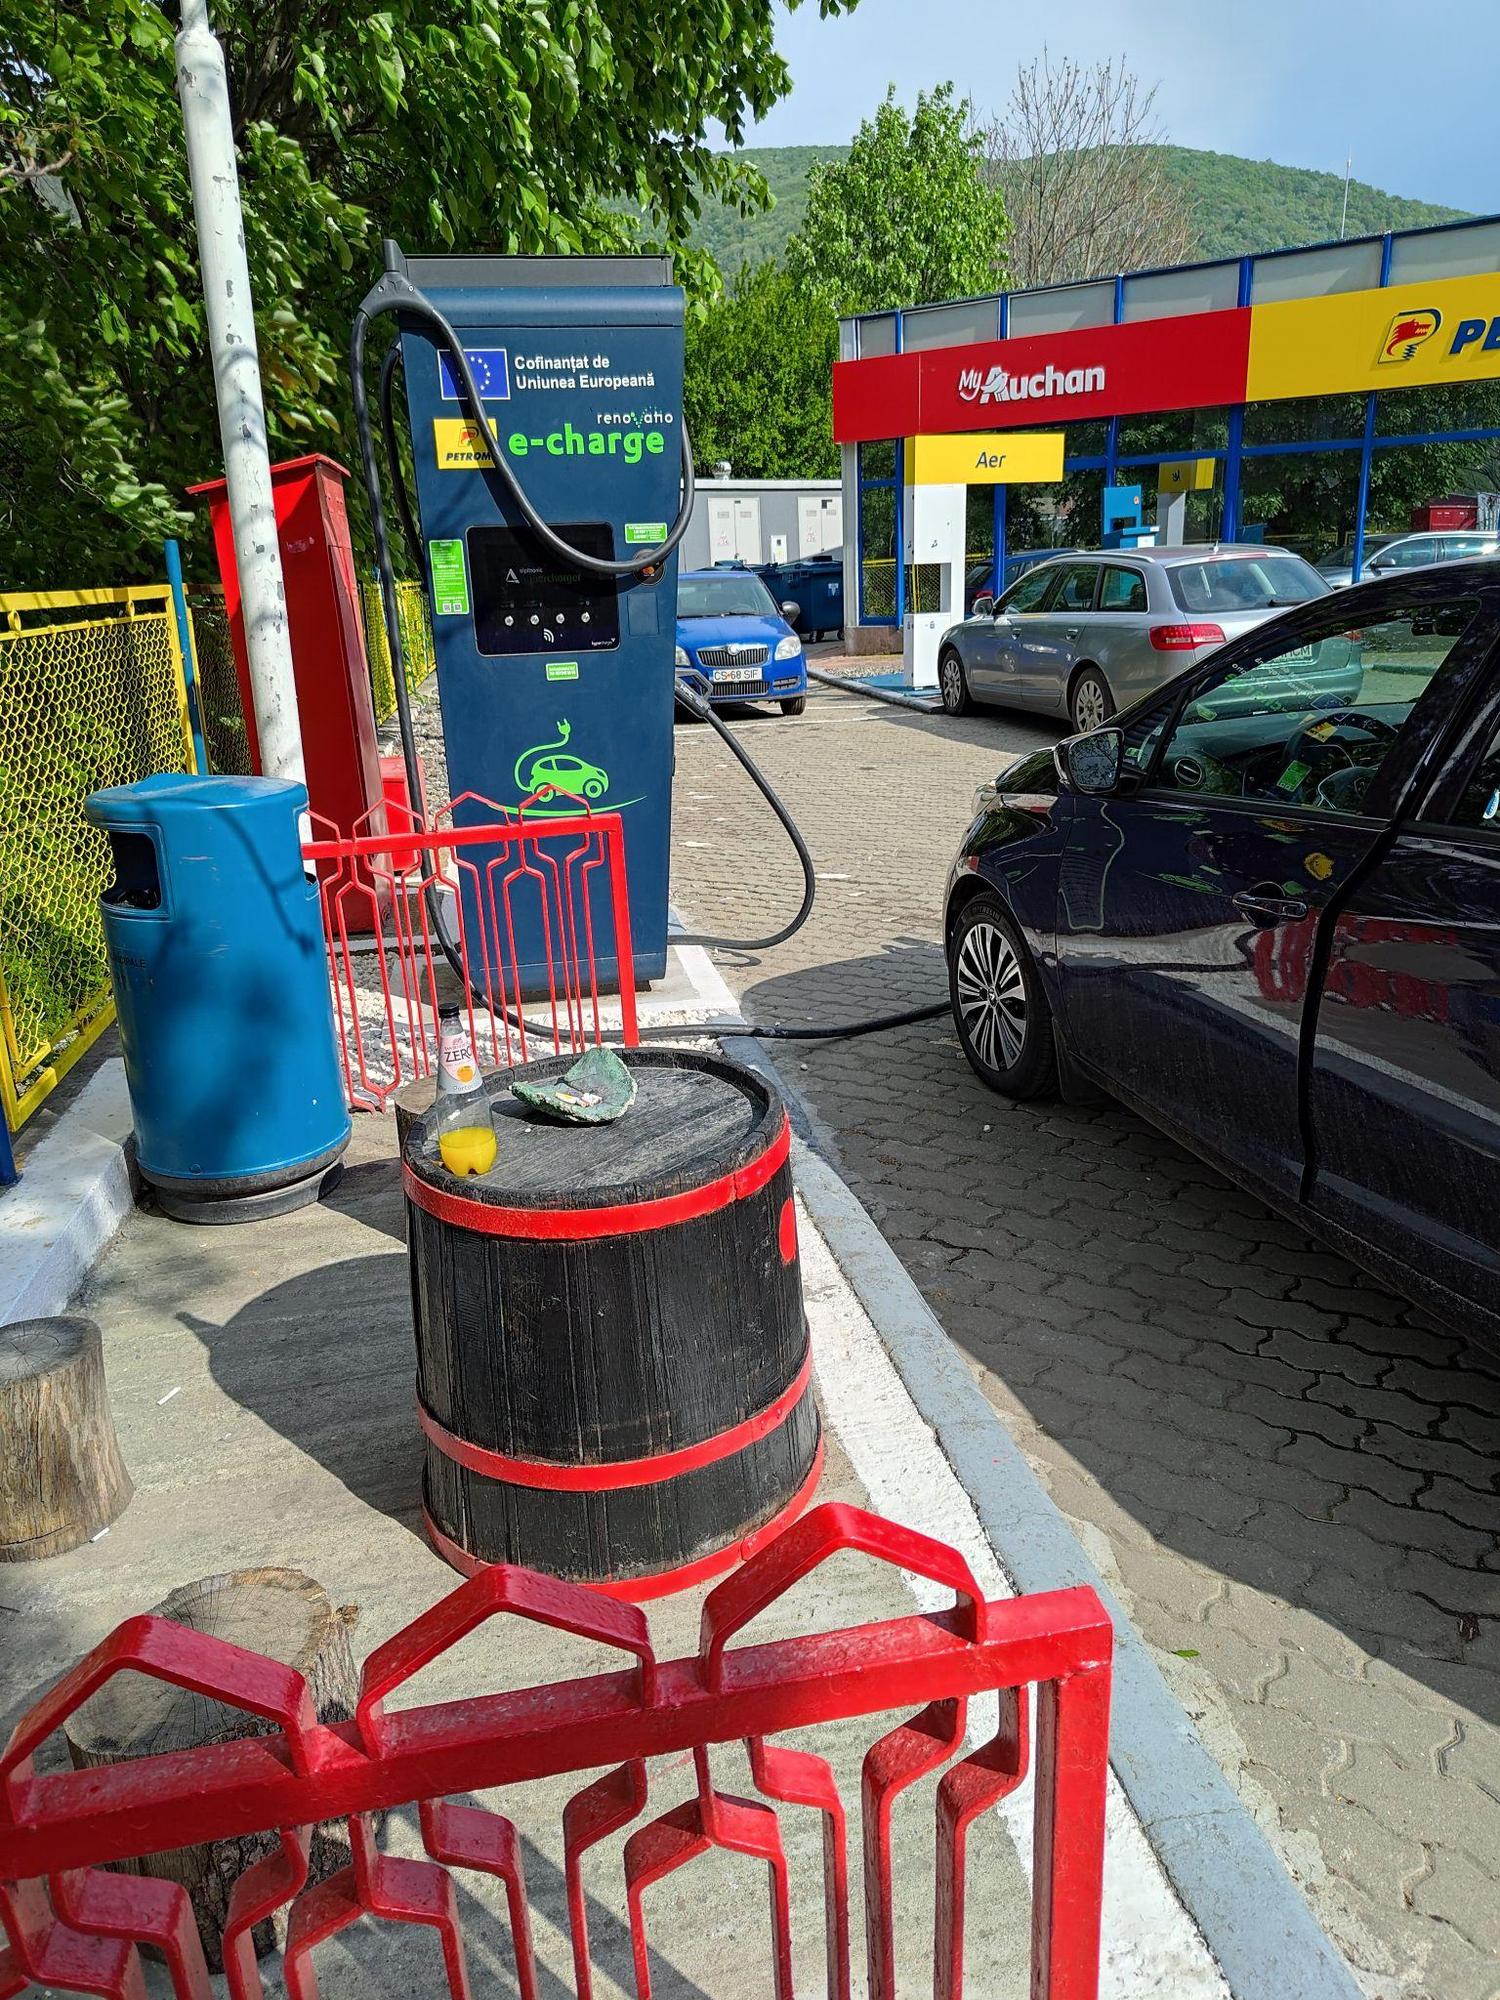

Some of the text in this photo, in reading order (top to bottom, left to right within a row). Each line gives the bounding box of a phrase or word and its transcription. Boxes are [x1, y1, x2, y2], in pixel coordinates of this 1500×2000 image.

[514, 354, 610, 373] Cofinanțat de
[516, 371, 655, 391] Uniunea Europeană
[508, 422, 665, 464] e-charge
[445, 451, 491, 462] PETROM
[975, 451, 1006, 469] Aer
[714, 669, 759, 681] CS 68 SIF
